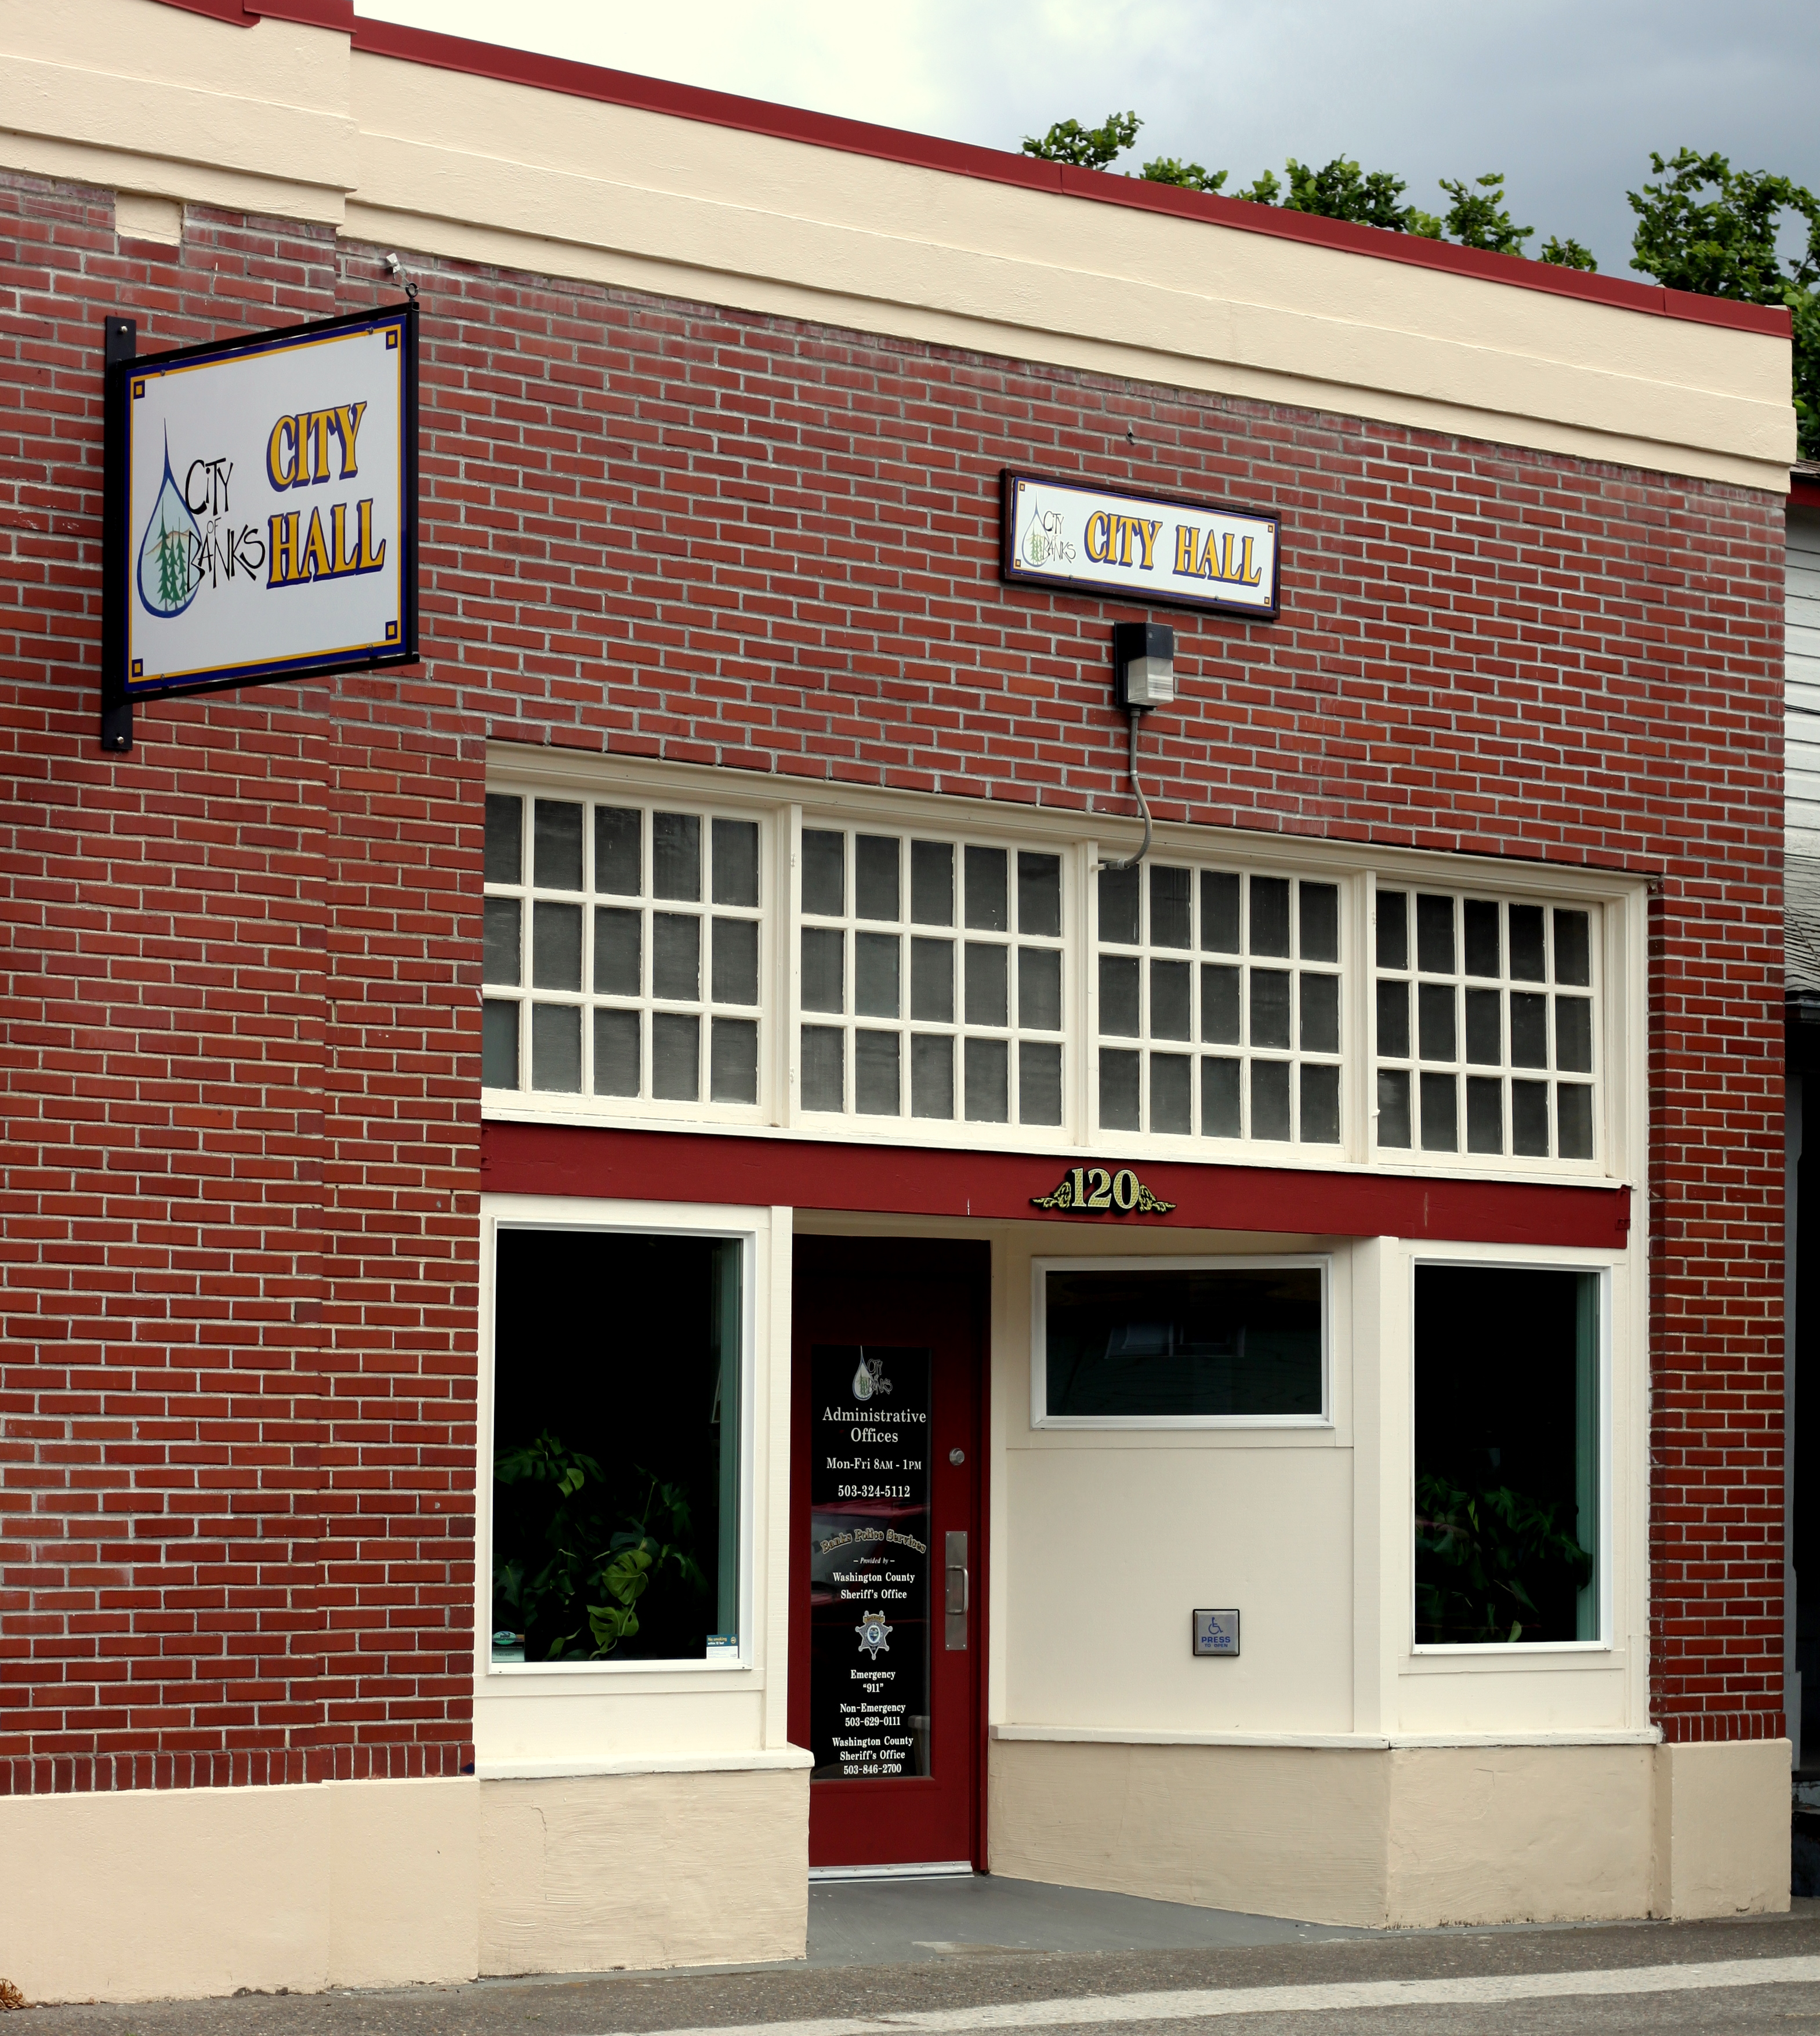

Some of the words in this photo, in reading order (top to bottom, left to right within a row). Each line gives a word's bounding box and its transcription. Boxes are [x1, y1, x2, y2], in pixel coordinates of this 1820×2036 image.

[266, 401, 367, 492] CITY
[206, 517, 221, 534] OF
[266, 498, 386, 590] HALL
[1042, 536, 1076, 564] BANKS
[1084, 510, 1163, 571] CITY
[1172, 525, 1262, 587] HALL
[186, 524, 266, 593] BANKS
[1072, 1167, 1140, 1209] 120
[822, 1406, 926, 1422] Administrative
[851, 1427, 898, 1443] Offices
[826, 1457, 871, 1469] Mon-Fri
[838, 1485, 910, 1497] 503-324-5112
[820, 1532, 853, 1554] Banks
[854, 1527, 884, 1542] Police
[886, 1529, 927, 1554] Services
[832, 1572, 882, 1584] Washington
[885, 1572, 915, 1584] County
[840, 1589, 878, 1599] Sheriff's
[881, 1589, 907, 1599] Office
[850, 1669, 896, 1681] Emergency
[840, 1703, 906, 1714] Non-Emergency
[845, 1716, 901, 1727] 503-629-0111
[832, 1737, 881, 1748] Washington
[884, 1736, 913, 1747] County
[840, 1750, 877, 1761] Sheriff's
[879, 1750, 905, 1759] Office
[843, 1763, 902, 1775] 503-846-2700
